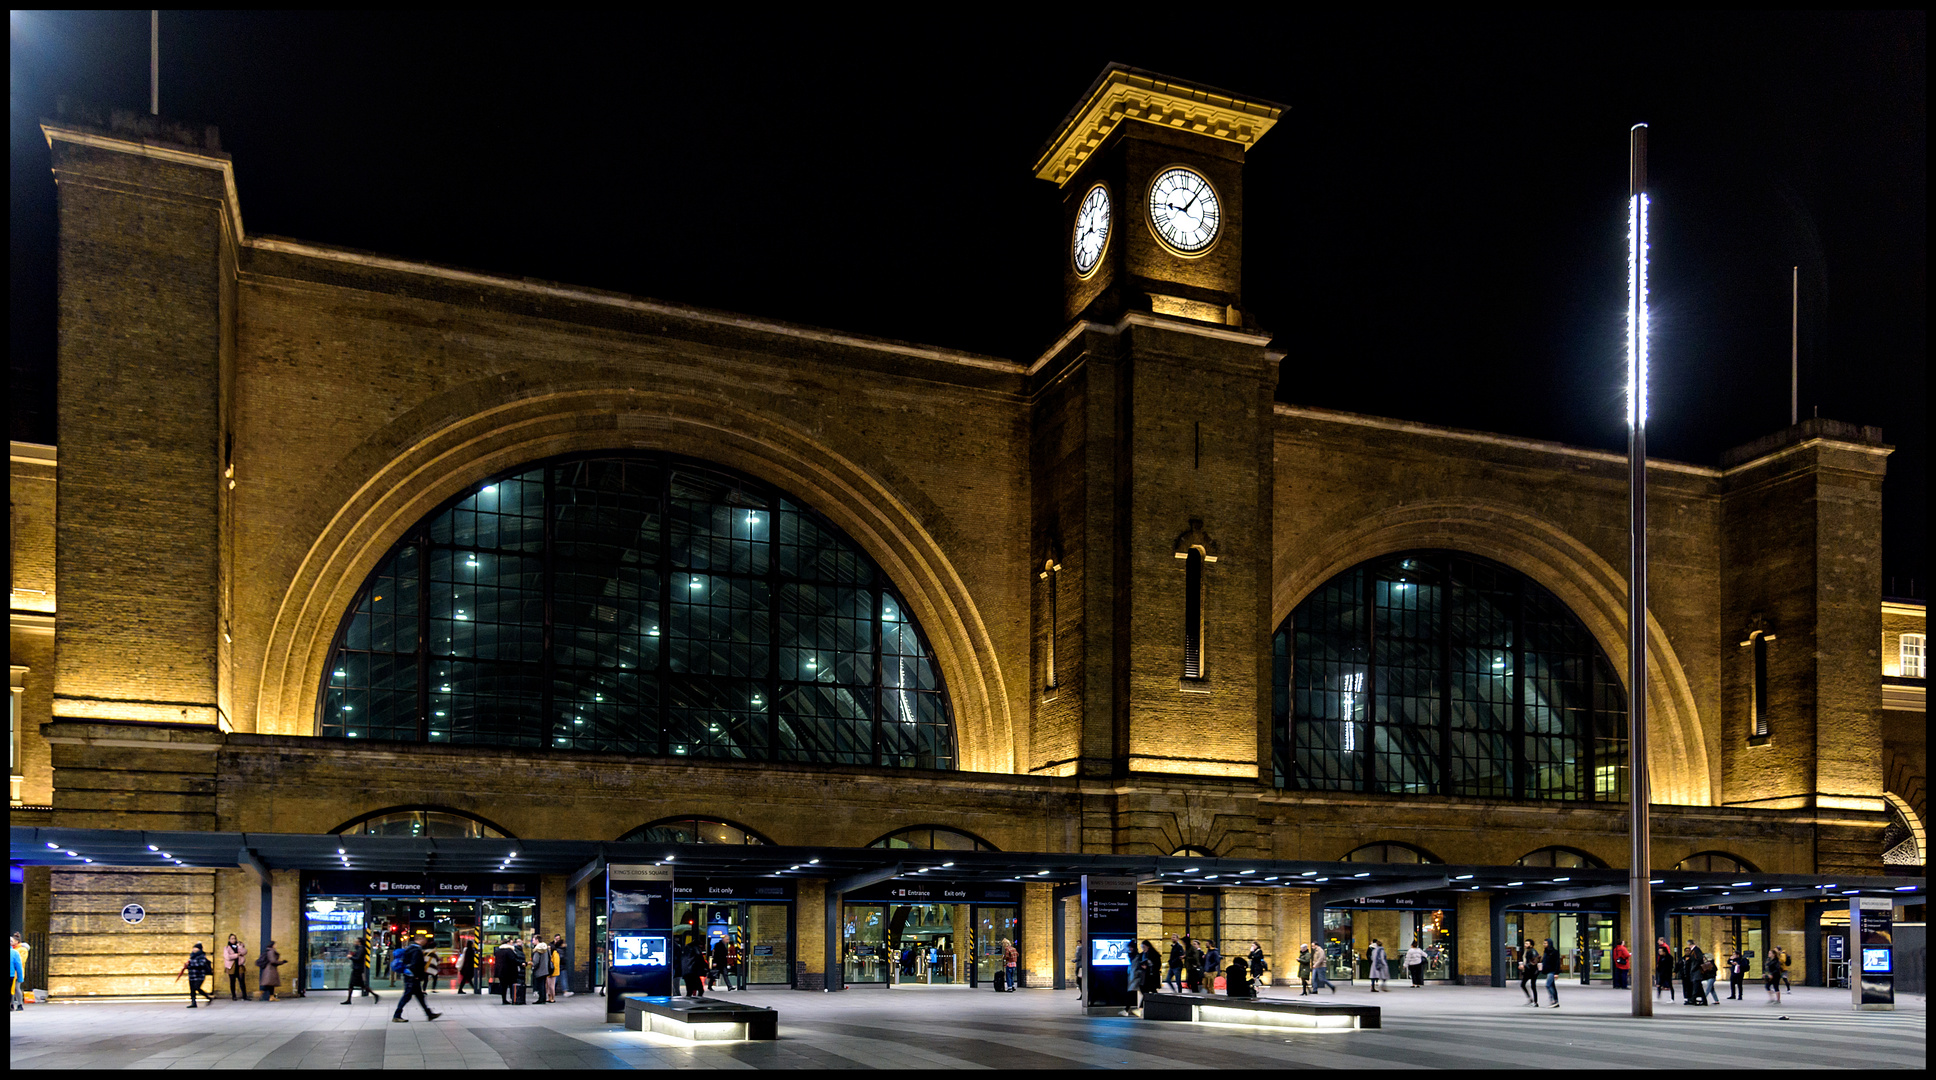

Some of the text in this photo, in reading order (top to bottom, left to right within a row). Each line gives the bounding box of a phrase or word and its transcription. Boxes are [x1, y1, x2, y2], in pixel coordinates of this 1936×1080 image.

[453, 883, 468, 892] only
[955, 890, 966, 898] only
[418, 909, 426, 919] 8
[715, 911, 721, 920] 6
